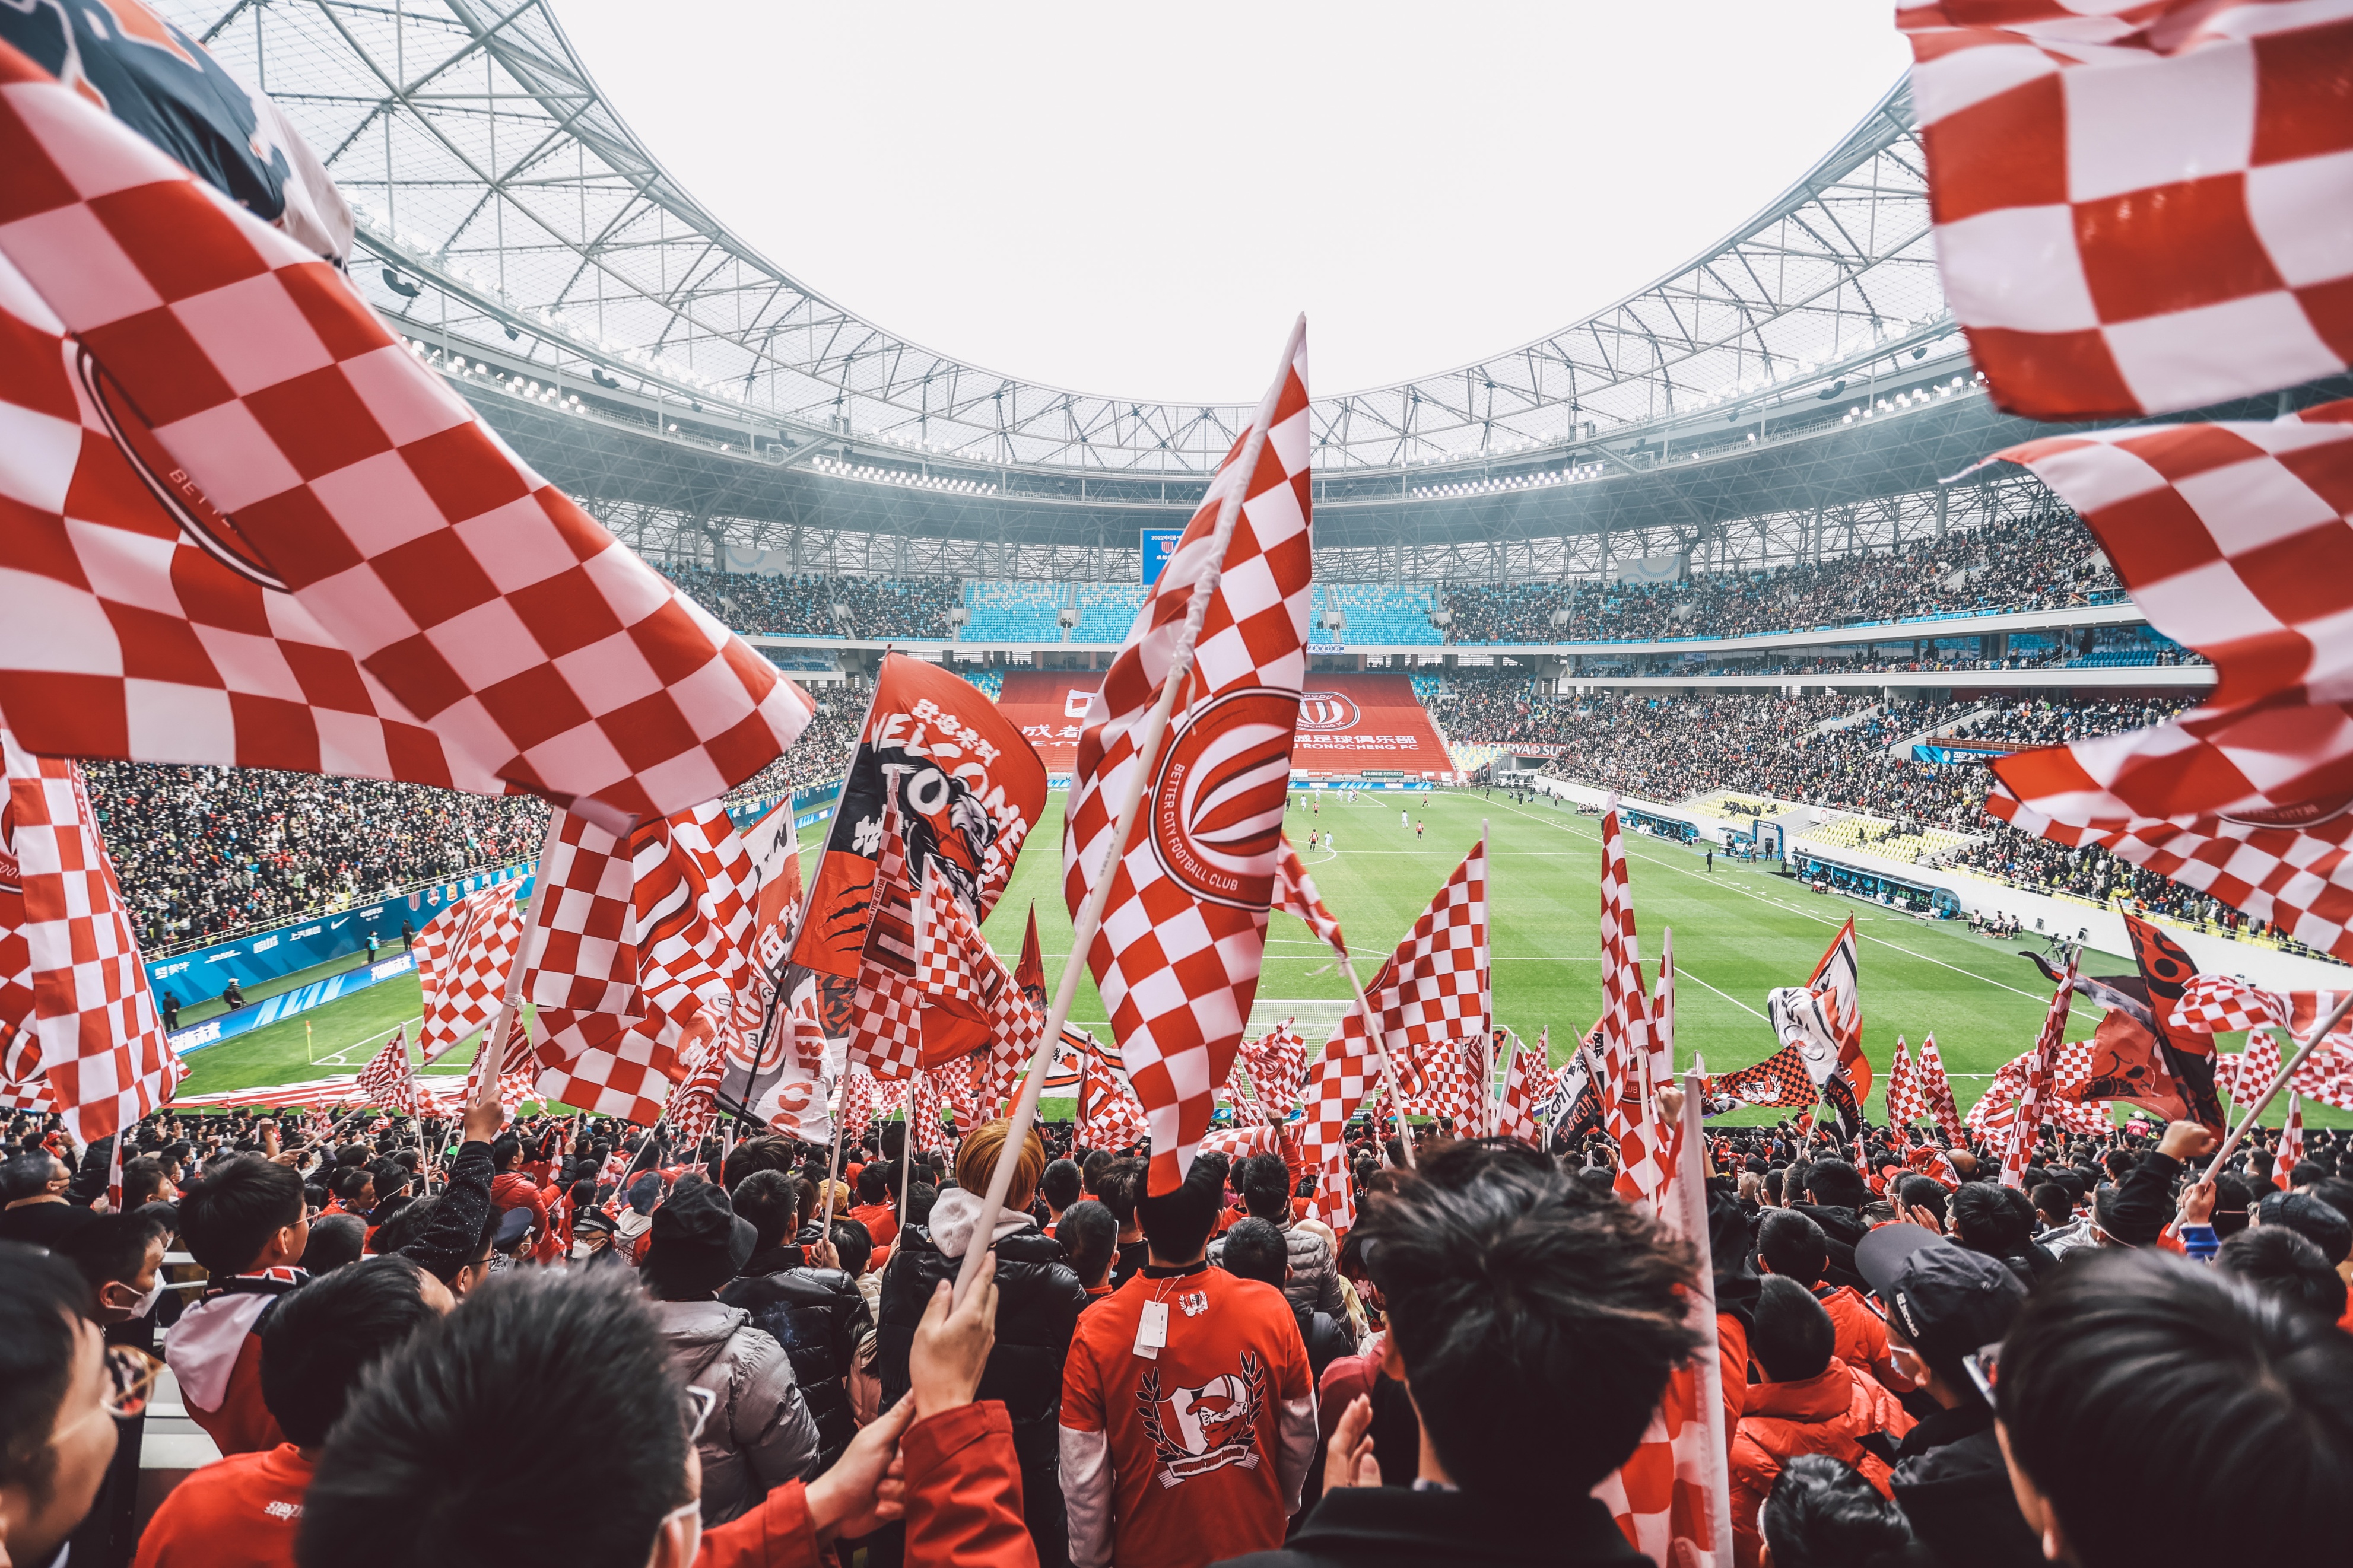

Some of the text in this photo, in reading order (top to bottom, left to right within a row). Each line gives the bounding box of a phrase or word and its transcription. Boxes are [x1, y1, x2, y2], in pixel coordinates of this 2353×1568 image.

[1164, 763, 1239, 892] BETTER CITY FOOTBALL CLUB
[1205, 1453, 1222, 1468] your
